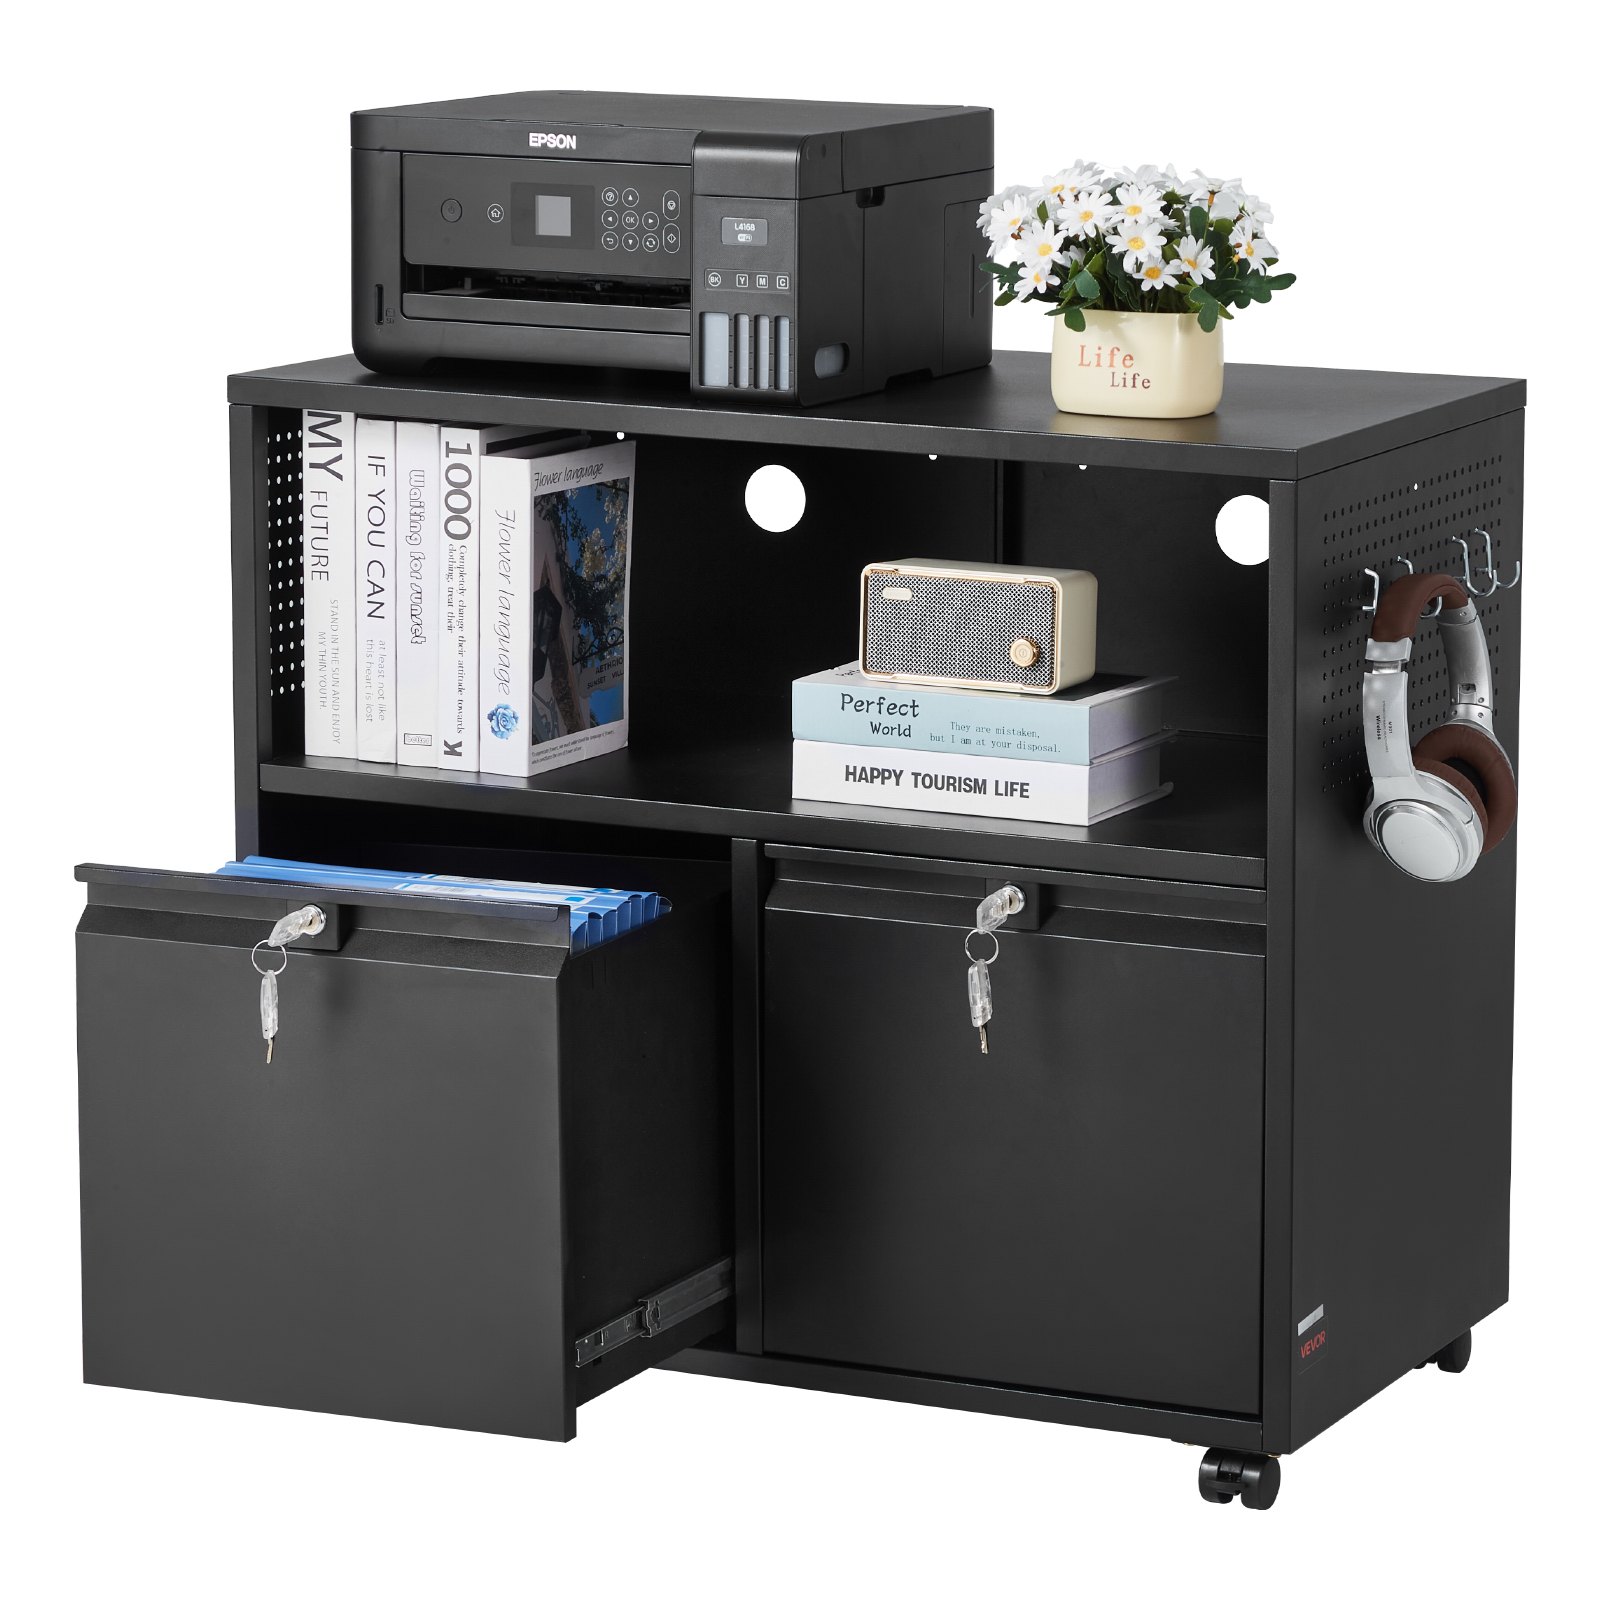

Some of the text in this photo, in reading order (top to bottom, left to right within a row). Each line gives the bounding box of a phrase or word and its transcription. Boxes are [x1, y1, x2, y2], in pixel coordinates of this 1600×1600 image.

[529, 132, 576, 150] EPSON
[625, 216, 635, 224] OK
[739, 276, 745, 285] Y
[759, 277, 766, 286] M
[779, 278, 786, 287] C
[1078, 344, 1135, 369] Life
[1110, 371, 1151, 390] Life
[444, 441, 472, 541] 1000
[534, 463, 603, 491] Flower language
[307, 410, 343, 582] MY FUTURE
[367, 454, 385, 620] IF YOU CAN
[406, 469, 426, 645] Waiting for sunset
[445, 544, 457, 583] clothing,
[494, 509, 516, 696] Flower language
[447, 612, 455, 633] their
[457, 545, 467, 734] Completely change their attitude towards
[318, 631, 327, 710] MY THIN YOUTH.
[330, 599, 341, 745] STAND IN THE SUN AND ENJOY
[365, 639, 374, 722] this heart is lost
[377, 639, 386, 721] at least not like
[840, 692, 920, 718] Perfect
[869, 721, 912, 738] World
[929, 732, 1062, 753] but I am at your disposal.
[950, 721, 1041, 739] They are mistaken,
[444, 740, 463, 757] K
[844, 764, 1031, 799] HAPPY TOURISM LIFE
[1300, 1330, 1326, 1359] VEVOR
